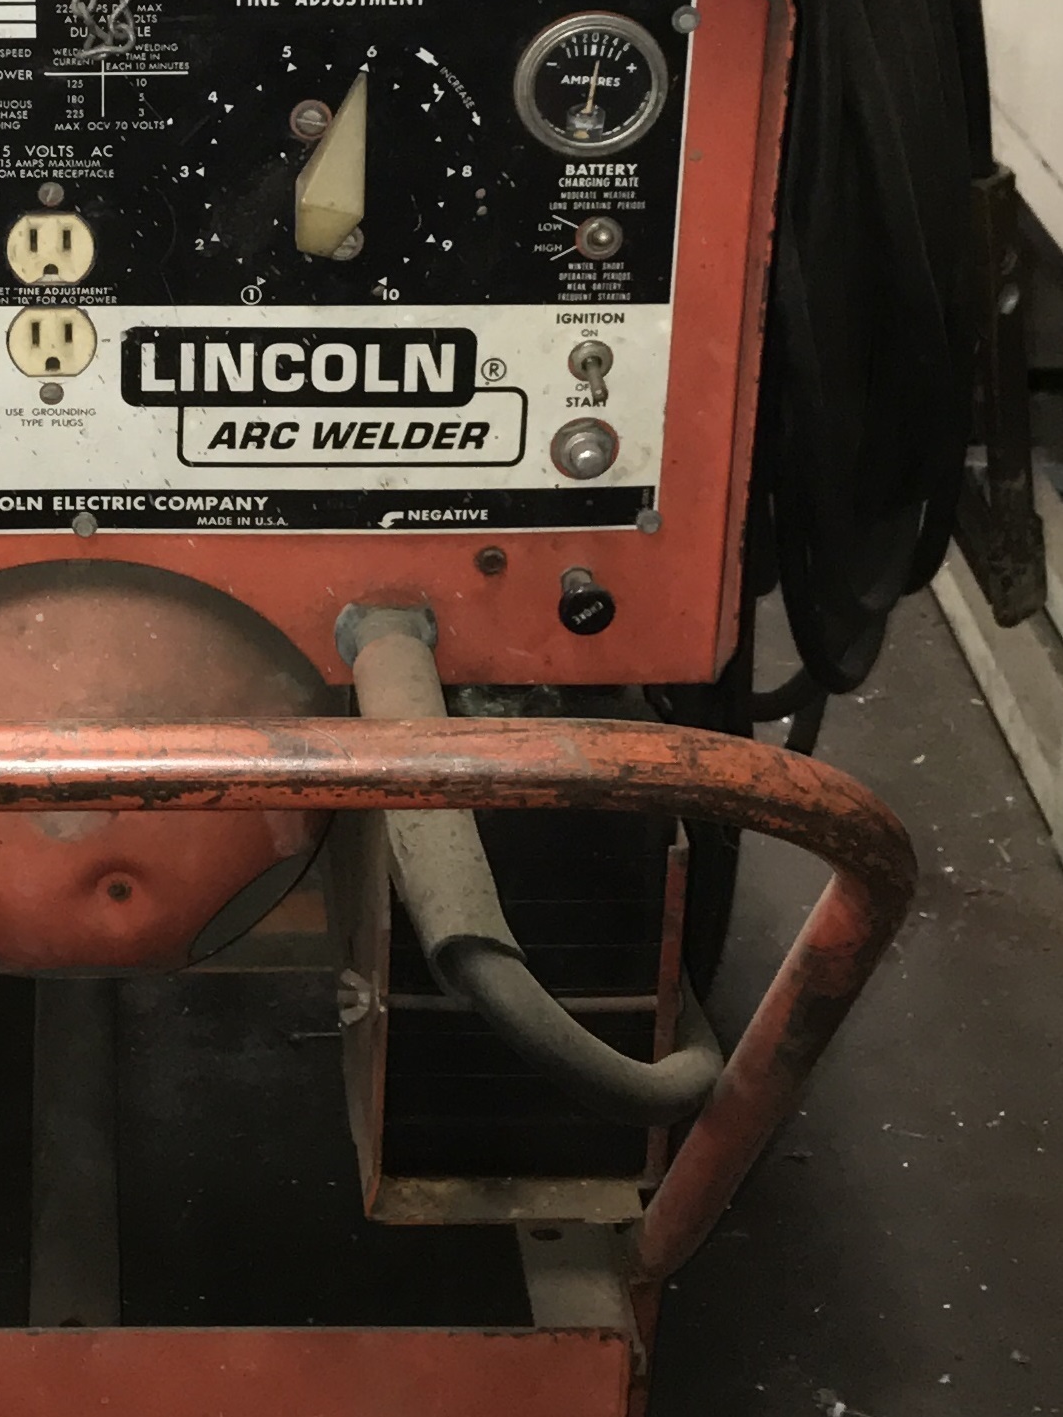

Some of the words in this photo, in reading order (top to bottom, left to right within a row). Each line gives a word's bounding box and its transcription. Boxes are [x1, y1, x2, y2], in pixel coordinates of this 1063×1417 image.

[136, 3, 163, 12] MAX
[64, 15, 78, 24] AT
[0, 48, 33, 58] SPEED
[134, 43, 179, 52] WELDING
[281, 46, 292, 58] 5
[366, 45, 378, 58] 6
[125, 52, 146, 61] TIME
[149, 52, 161, 61] IN
[105, 62, 132, 71] EACH
[135, 62, 146, 71] 10
[148, 62, 190, 71] MINUTES
[66, 79, 84, 89] 125
[135, 78, 148, 87] 10
[439, 66, 476, 110] INCREASE
[66, 94, 85, 104] 180
[138, 92, 145, 102] 5
[207, 91, 219, 104] 4
[65, 109, 85, 119] 225
[138, 108, 145, 117] 3
[54, 123, 80, 131] MAX
[87, 121, 111, 131] OCV
[115, 121, 128, 130] 70
[131, 120, 166, 130] VOLTS
[24, 144, 75, 158] VOLTS
[90, 144, 114, 157] AC
[0, 158, 12, 168] 15
[15, 159, 45, 168] AMPS
[48, 159, 101, 168] MAXIMUM
[19, 169, 49, 179] EACH
[52, 169, 115, 179] RECEPTACLE
[179, 165, 190, 178] 3
[461, 165, 473, 178] 8
[565, 164, 638, 176] BATTERY
[558, 177, 610, 187] CHARGING
[614, 177, 639, 187] RATE
[538, 222, 563, 232] LOW
[194, 238, 205, 251] 2
[441, 239, 453, 252] 9
[533, 244, 563, 253] HIGH
[36, 296, 57, 304] FOR
[79, 295, 118, 305] POWER
[382, 288, 400, 301] 10
[556, 312, 625, 325] IGNITION
[581, 328, 599, 337] ON
[140, 342, 456, 393] LINCOLN
[5, 408, 25, 417] USE
[32, 408, 97, 417] GROUNDING
[20, 418, 44, 427] TYPE
[52, 418, 84, 427] PLUGS
[207, 421, 299, 450] ARC
[312, 421, 490, 450] WELDER
[53, 495, 146, 510] ELECTRIC
[154, 495, 269, 511] COMPANY
[407, 508, 489, 521] NEGATIVE
[196, 516, 235, 526] MADE
[237, 516, 251, 526] IN
[255, 516, 289, 526] U.S.A.
